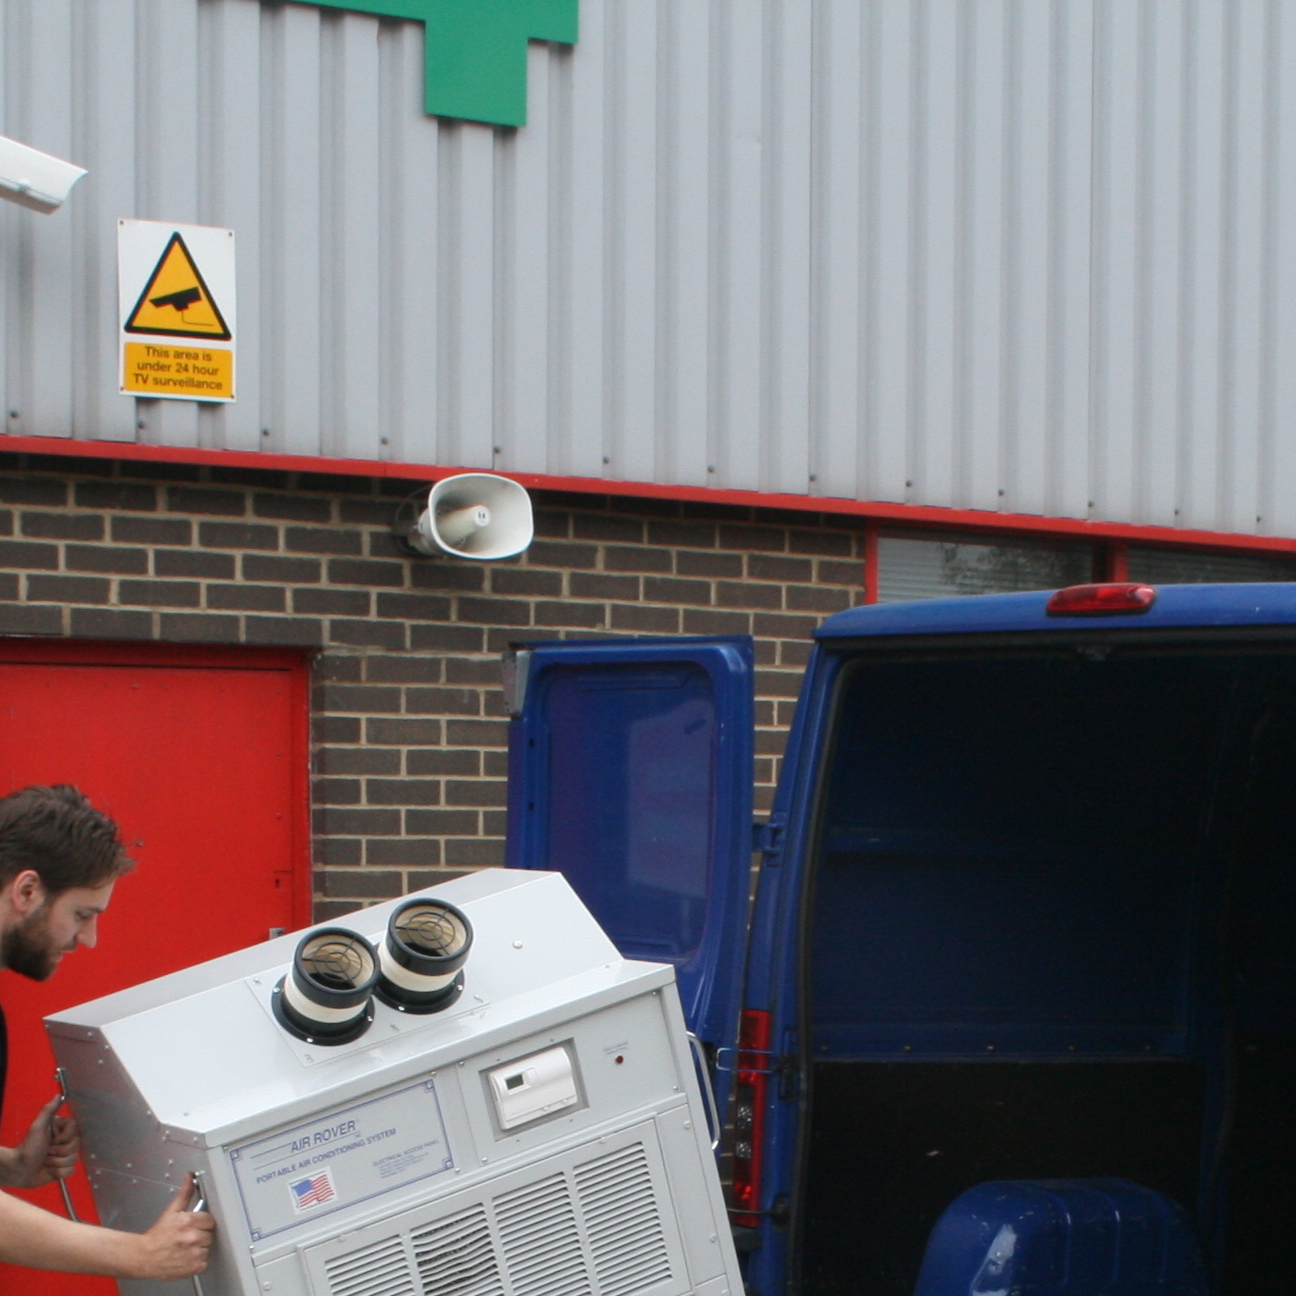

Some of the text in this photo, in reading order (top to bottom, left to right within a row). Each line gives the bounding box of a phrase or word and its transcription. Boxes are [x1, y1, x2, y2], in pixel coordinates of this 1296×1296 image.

[145, 346, 212, 361] This area is
[137, 361, 219, 376] under 24 hour
[133, 372, 223, 390] TV surveillance
[290, 1120, 356, 1153] AIR ROVER
[256, 1128, 397, 1184] PORTABLE AIR CONDITIONING SYSTEM
